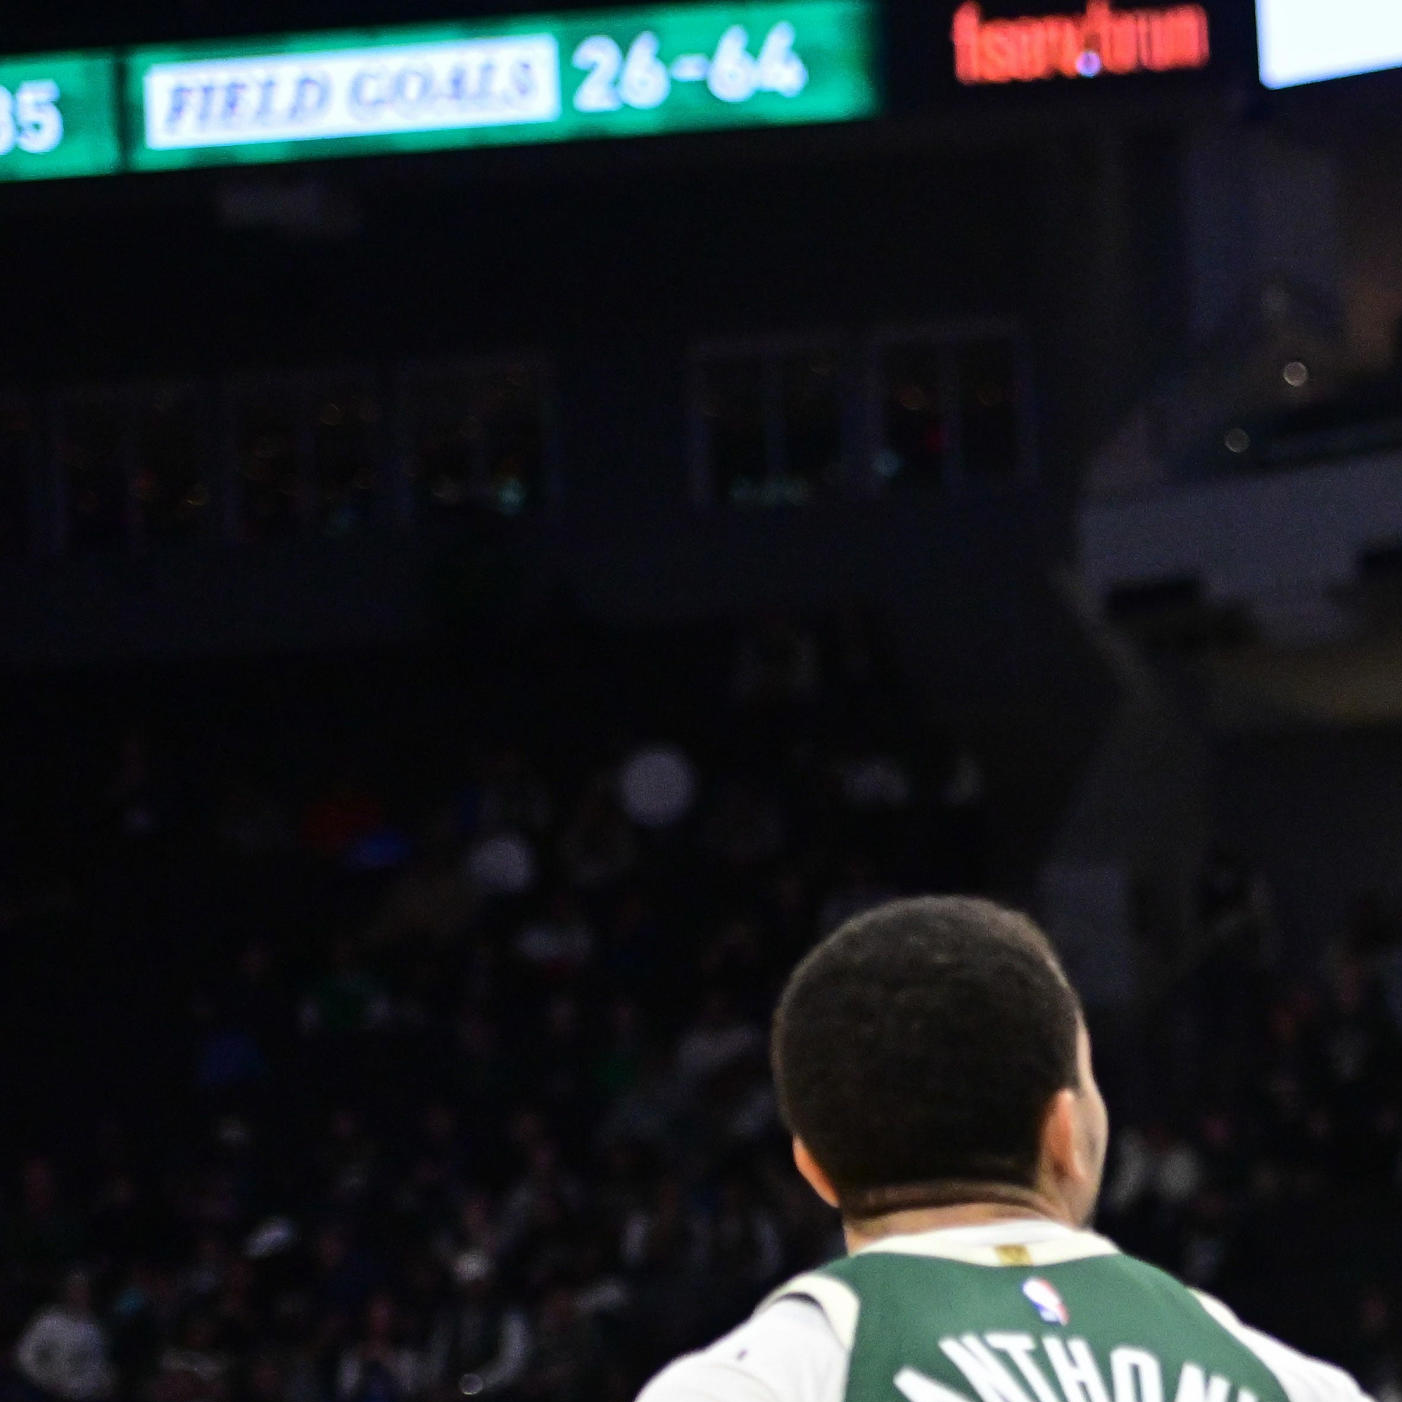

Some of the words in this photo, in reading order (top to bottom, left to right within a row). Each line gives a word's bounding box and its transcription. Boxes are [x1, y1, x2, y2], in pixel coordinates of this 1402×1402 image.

[163, 68, 333, 134] FIELD
[347, 51, 539, 122] GOALS
[570, 21, 809, 113] 26-64
